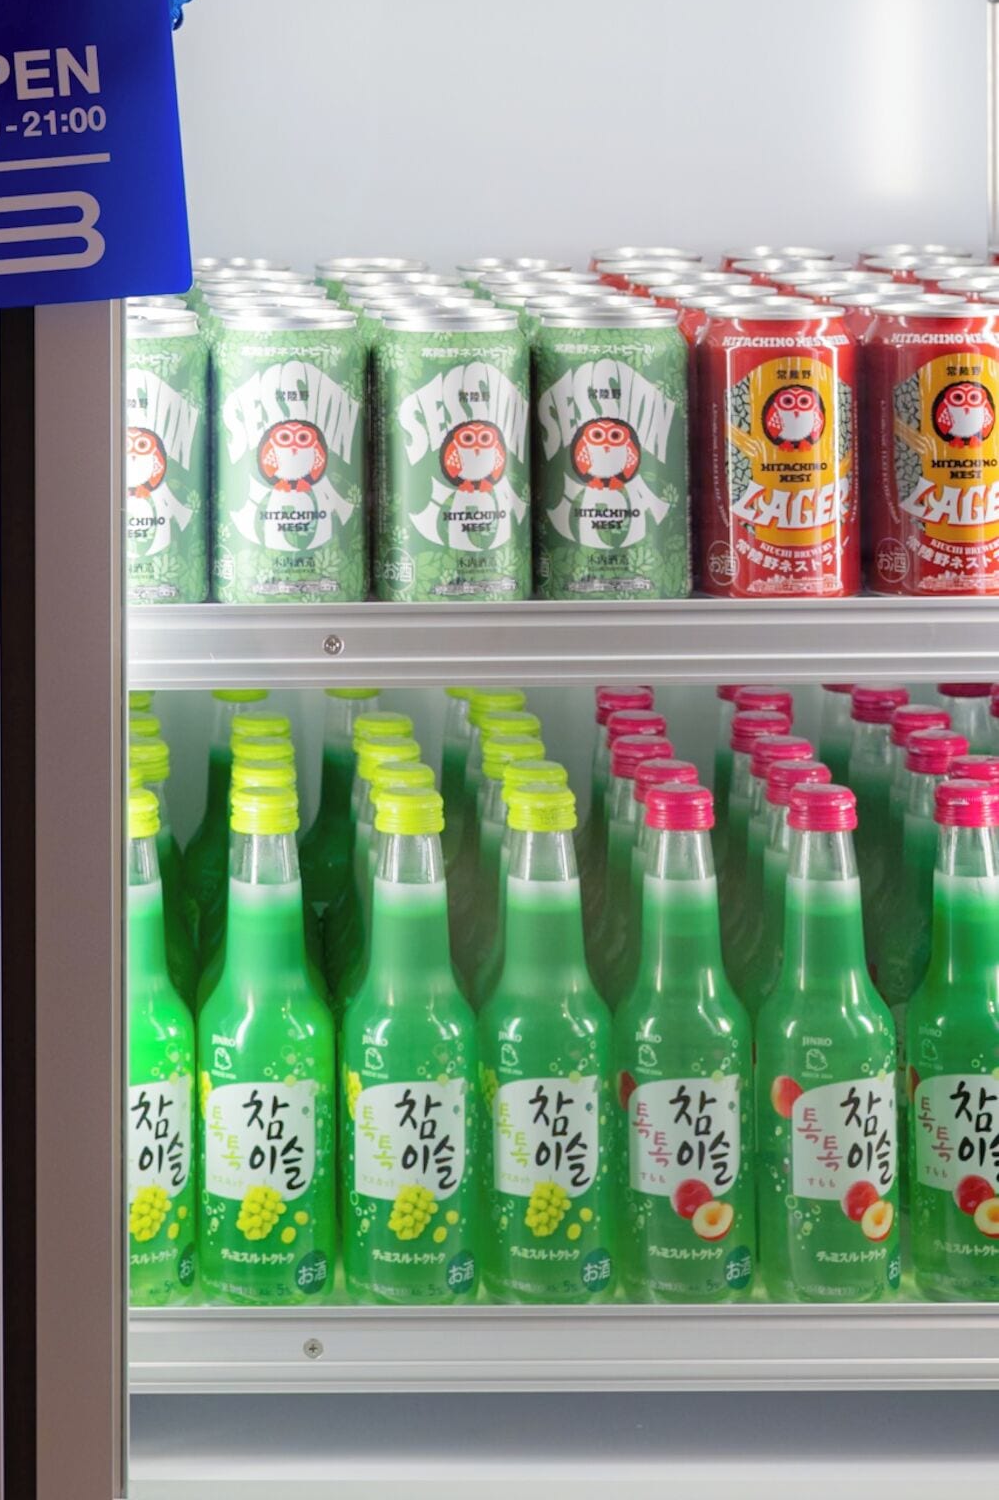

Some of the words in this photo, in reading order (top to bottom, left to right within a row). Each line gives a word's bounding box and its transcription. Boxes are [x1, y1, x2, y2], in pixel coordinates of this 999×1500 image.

[722, 335, 793, 347] HITACHINO
[891, 333, 962, 345] HITACHINO
[776, 369, 812, 380] 常陸野
[946, 365, 982, 377] 常陸野
[760, 461, 828, 472] HITACHINO
[930, 458, 998, 469] HITACHINO
[779, 472, 812, 483] NEST
[950, 470, 983, 480] NEST
[731, 478, 849, 530] LAGER
[900, 476, 999, 527] LAGE
[259, 510, 327, 521] HITACHINO
[442, 510, 507, 521] HITACHINO
[574, 508, 641, 519] HITACHINO
[277, 521, 311, 532] NEST
[461, 521, 494, 533] NEST
[590, 519, 624, 530] NEST
[877, 548, 908, 573] お酒
[802, 1035, 833, 1048] JINRO
[448, 1259, 475, 1285] お酒
[583, 1258, 611, 1284] お酒
